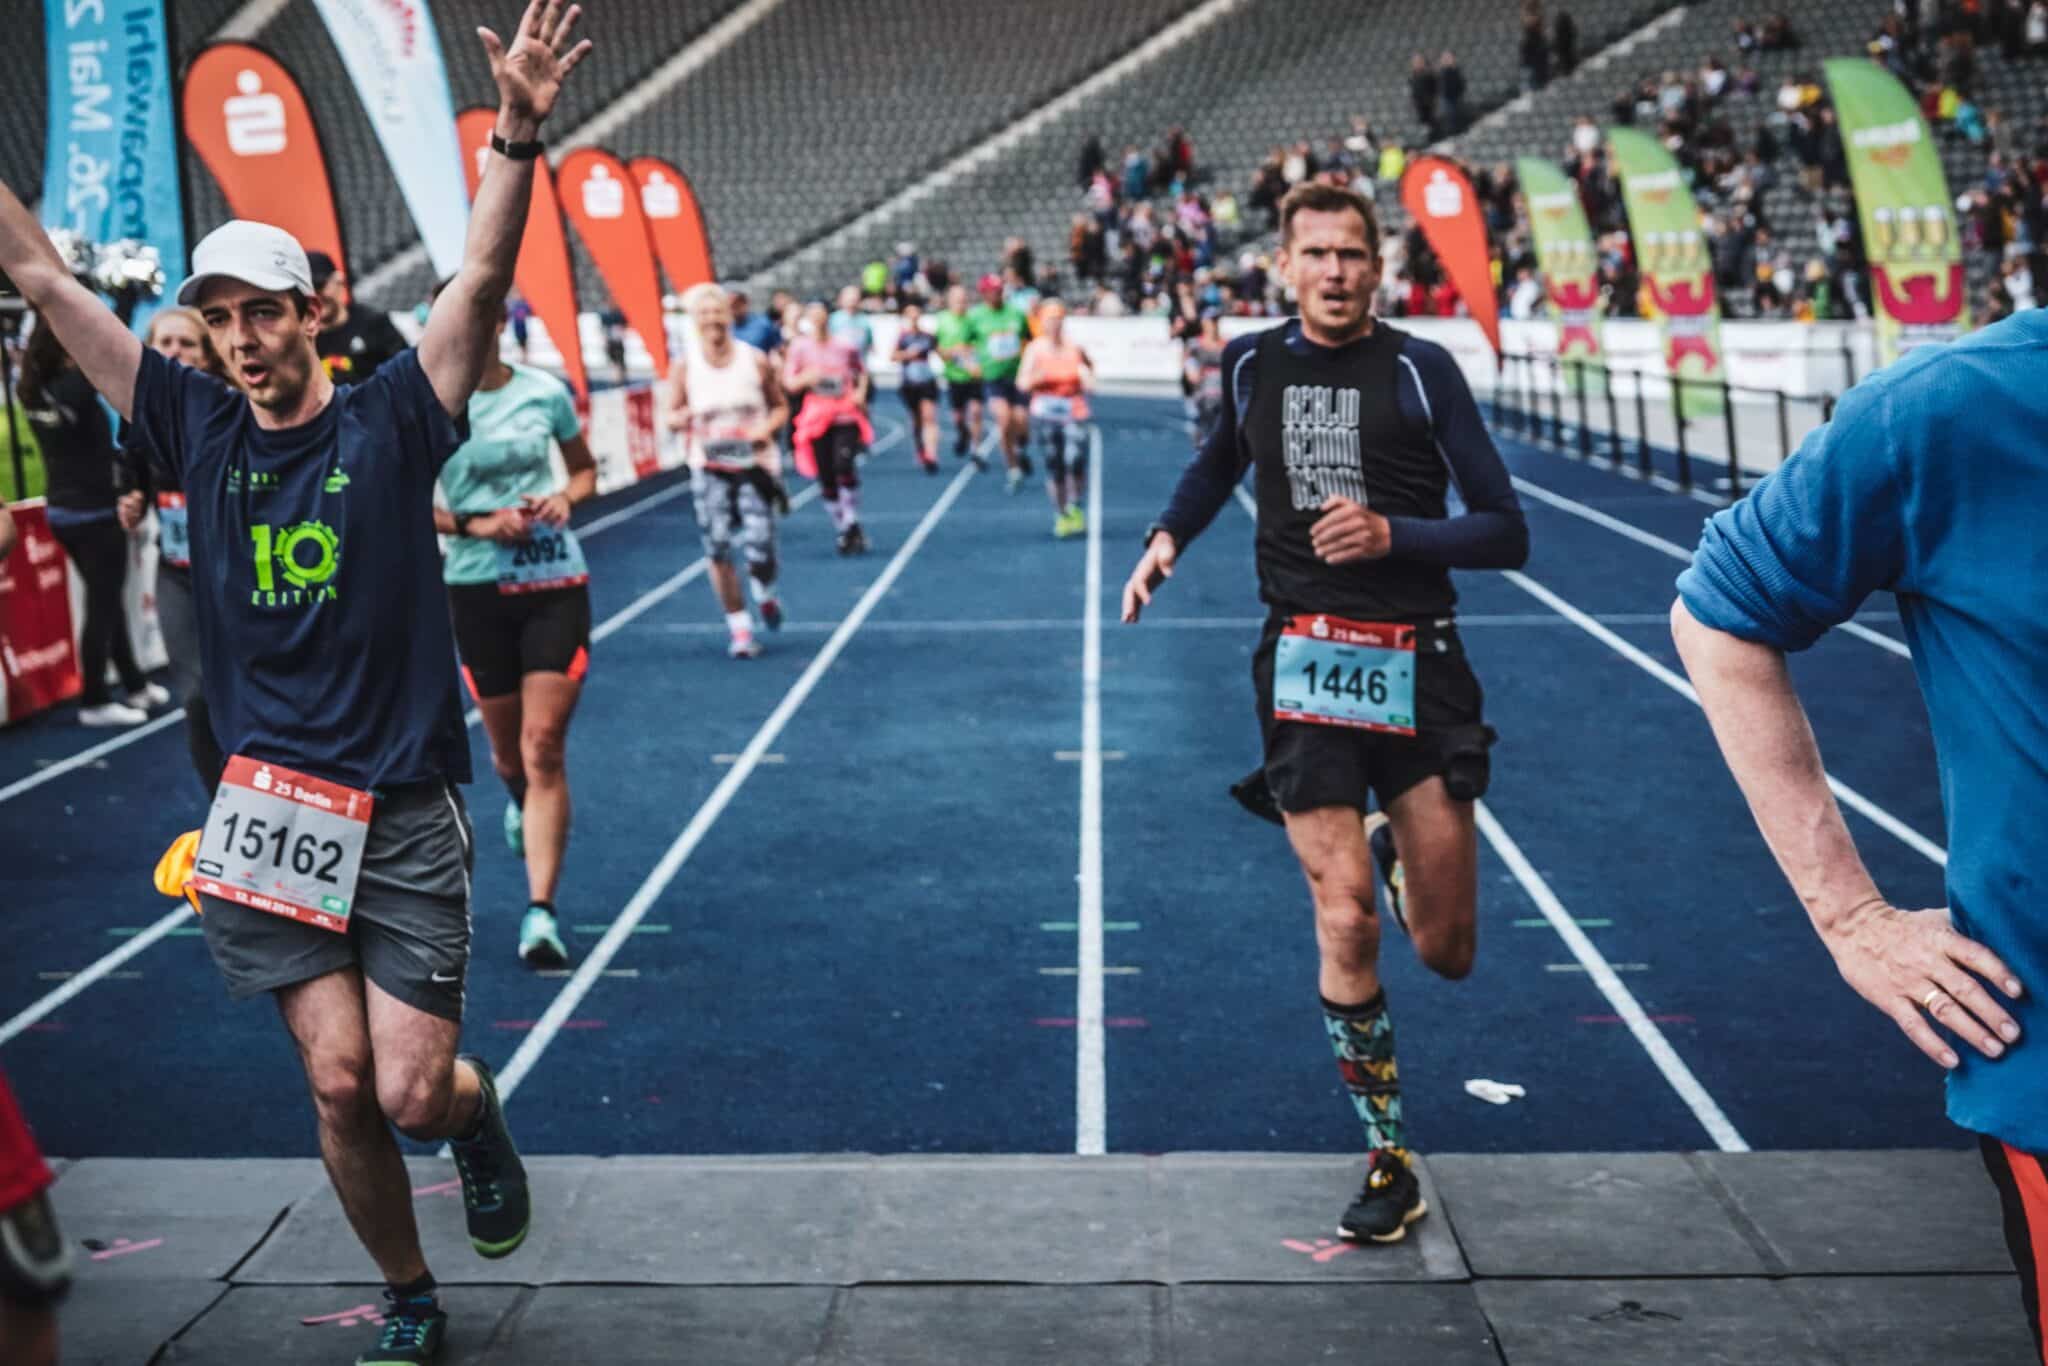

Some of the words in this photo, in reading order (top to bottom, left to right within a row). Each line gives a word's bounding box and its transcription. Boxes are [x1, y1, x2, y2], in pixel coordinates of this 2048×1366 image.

[251, 519, 340, 591] 10
[1350, 632, 1381, 644] Berlin
[1302, 660, 1388, 706] 1446
[274, 781, 291, 797] 25
[294, 788, 332, 808] Berlin
[223, 812, 344, 884] 15162
